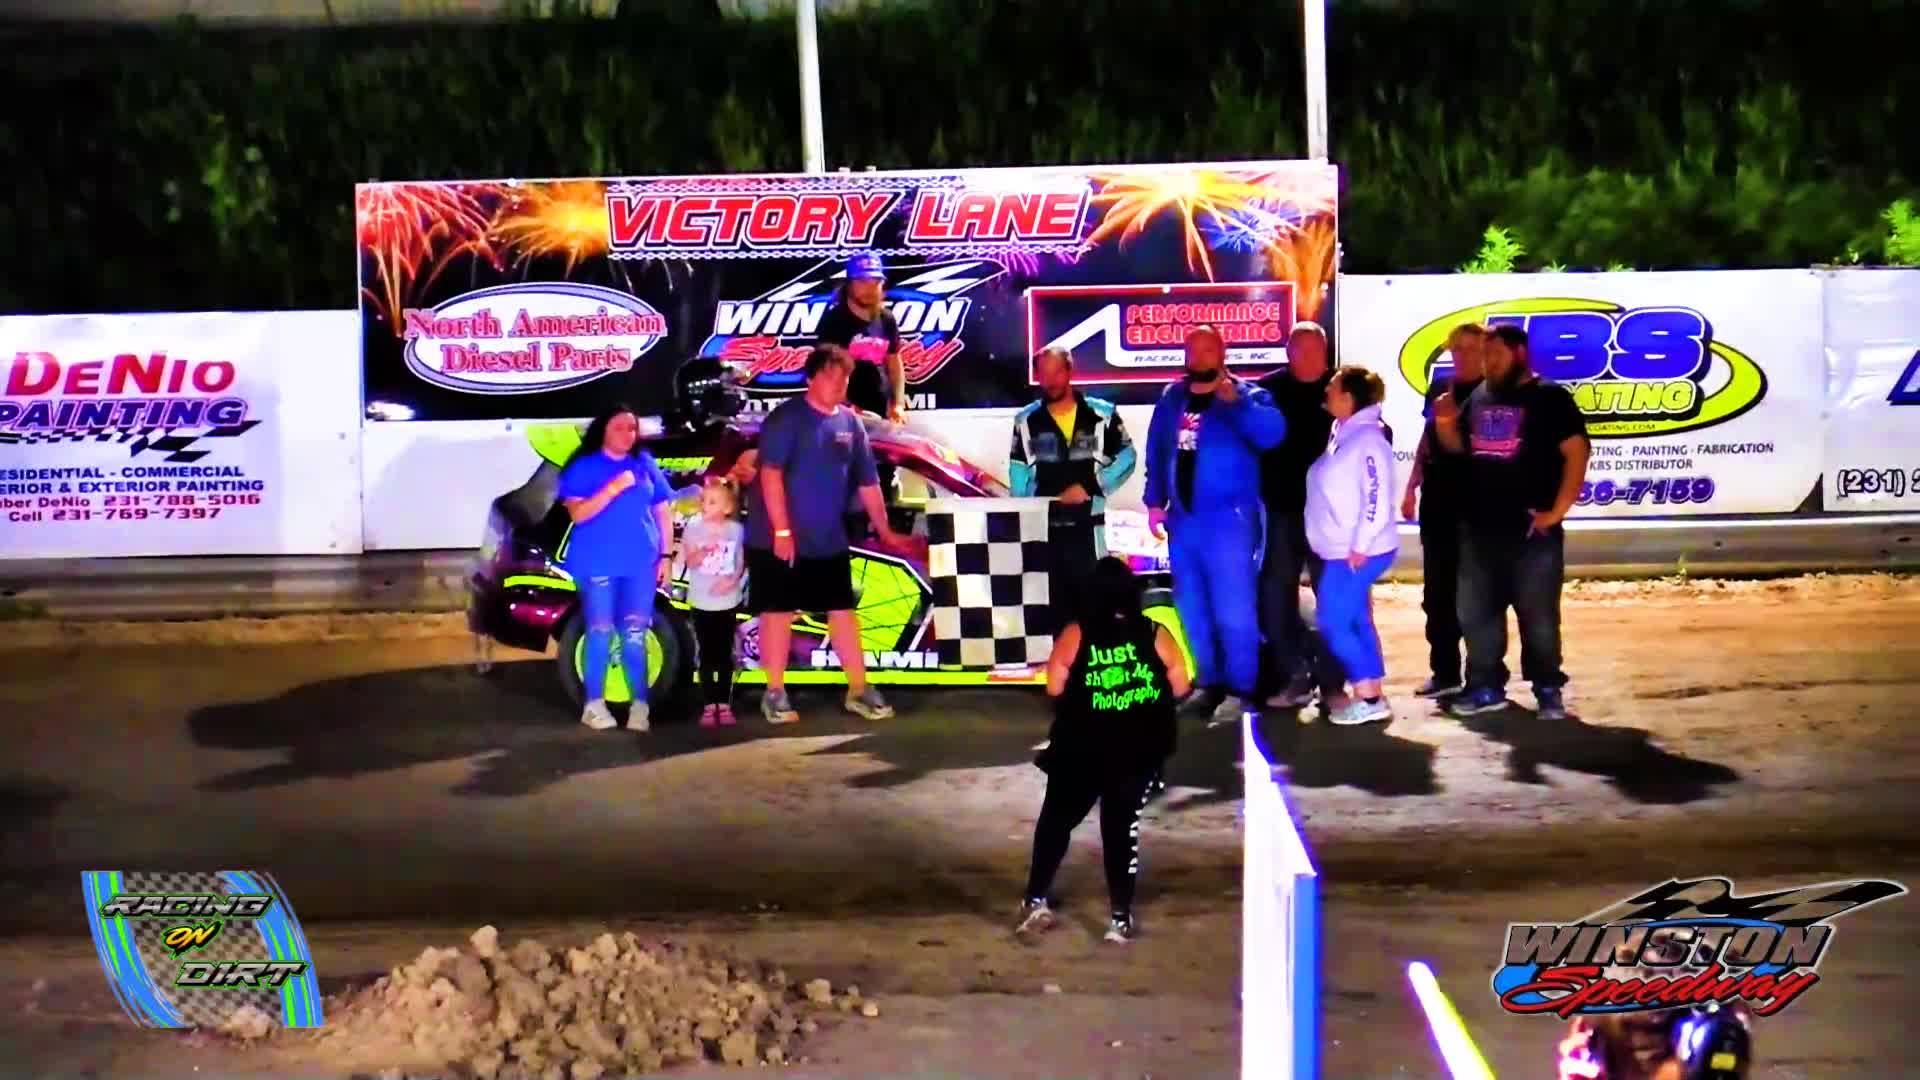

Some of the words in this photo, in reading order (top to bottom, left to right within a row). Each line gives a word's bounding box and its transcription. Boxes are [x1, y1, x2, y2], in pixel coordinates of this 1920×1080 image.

[607, 192, 891, 247] VICTORY
[906, 190, 1086, 244] LANE
[404, 308, 502, 338] North
[508, 306, 667, 338] American
[716, 300, 966, 335] WINON
[1127, 302, 1280, 324] PERFORMANCE
[1126, 322, 1281, 344] ENGIRING
[441, 343, 541, 373] Diesel
[548, 342, 634, 372] Parts
[904, 393, 936, 409] MI
[1572, 380, 1697, 413] ATING
[0, 398, 248, 430] PAINTING
[1632, 445, 1688, 456] PAINTING
[1697, 443, 1774, 455] FABRICATION
[121, 466, 245, 478] COMMERCIAL
[1615, 459, 1693, 470] DISTRIBUTOR
[58, 482, 71, 493] &
[79, 481, 170, 493] EXTERIOR
[177, 480, 264, 492] PAINTING
[1837, 468, 1906, 498] (231)
[0, 498, 32, 508] ber
[38, 497, 90, 508] DeNio
[9, 511, 42, 522] Cell
[53, 508, 221, 521] 231-769-7397
[1087, 642, 1138, 667] Just
[1093, 686, 1160, 711] Photography
